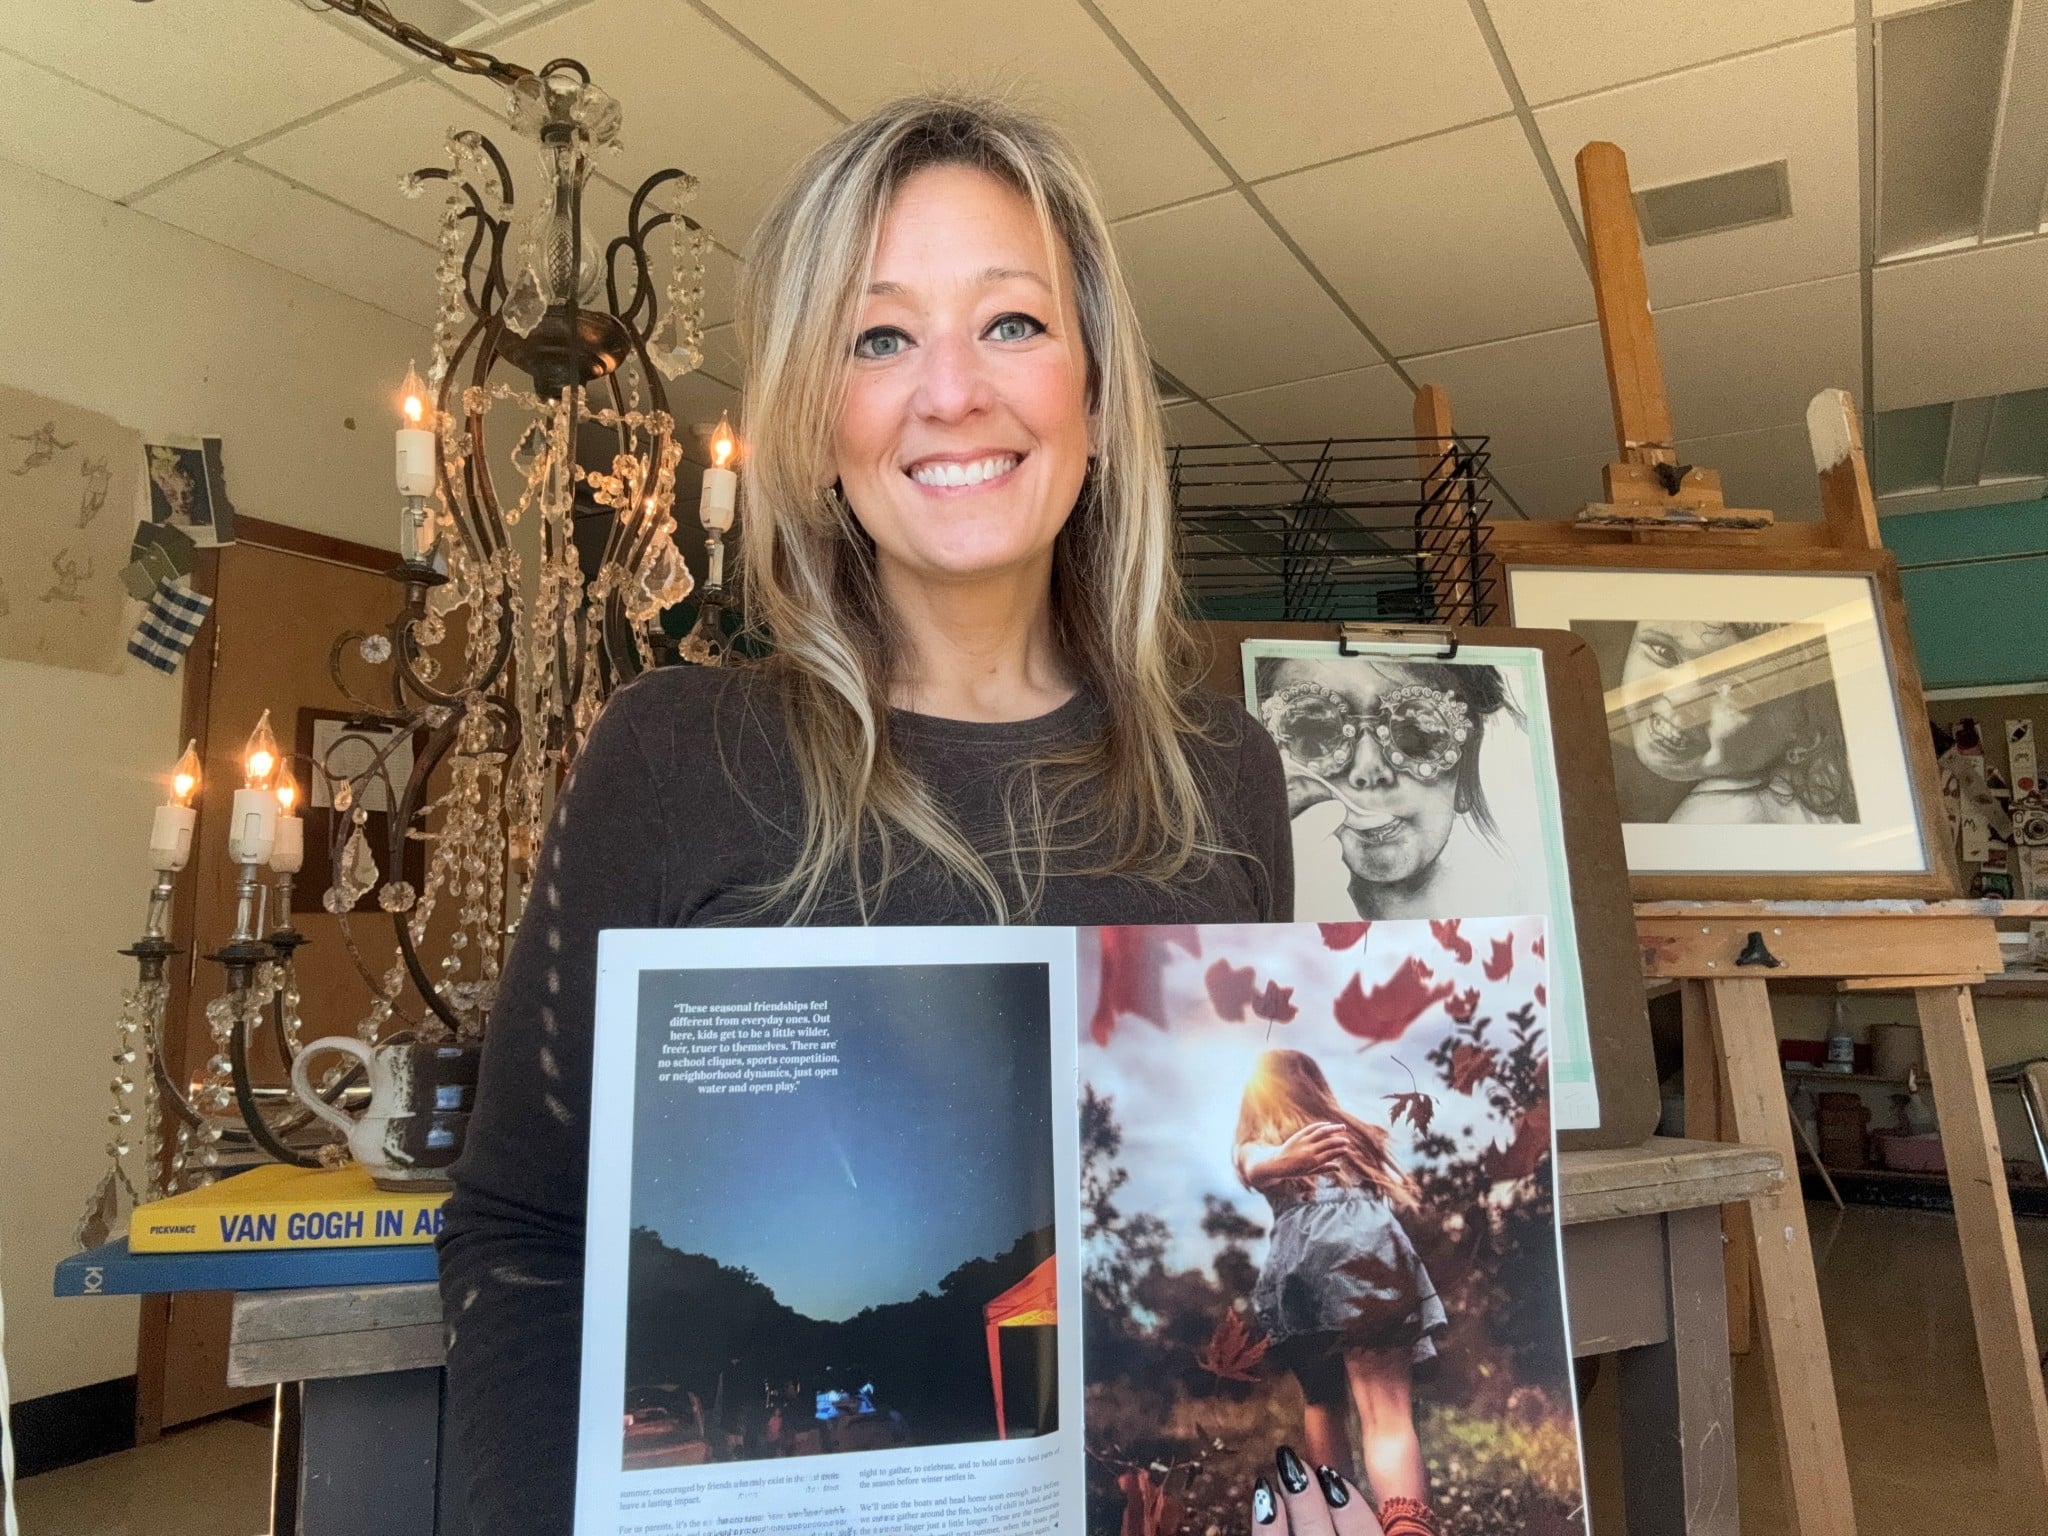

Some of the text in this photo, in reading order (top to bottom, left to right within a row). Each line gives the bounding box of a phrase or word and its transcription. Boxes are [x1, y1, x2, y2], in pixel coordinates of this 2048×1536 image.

[709, 1002, 752, 1013] seasonal
[753, 1001, 808, 1013] friendships
[810, 1000, 828, 1010] feel
[669, 1013, 831, 1027] different from everyday ones. Out
[670, 1026, 830, 1041] here, kids get to be a little wilder,
[662, 1041, 837, 1054] freer, truer to themselves. There are
[658, 1053, 840, 1068] no school cliques, sports competition,
[659, 1067, 838, 1083] or neighborhood dynamics, just open
[698, 1085, 727, 1093] water
[728, 1082, 747, 1093] and
[749, 1084, 773, 1094] open
[150, 1225, 196, 1235] PICKVANCE
[219, 1214, 276, 1242] VAN
[287, 1211, 363, 1240] GOGH
[375, 1209, 404, 1237] IN
[860, 1468, 878, 1478] night
[889, 1466, 912, 1476] gather,
[923, 1463, 957, 1472] celebrate,
[959, 1461, 971, 1469] and
[982, 1458, 997, 1467] hold
[1016, 1455, 1026, 1463] the
[620, 1488, 652, 1498] summer,
[653, 1484, 695, 1495] encouraged
[697, 1483, 706, 1493] by
[707, 1480, 732, 1490] friends
[768, 1476, 785, 1485] exist
[786, 1475, 793, 1483] in
[860, 1471, 976, 1489] the season before winter settles in.
[620, 1501, 640, 1511] leave
[648, 1498, 673, 1508] lasting
[675, 1496, 701, 1506] impact.
[881, 1501, 899, 1510] untie
[901, 1500, 912, 1508] the
[914, 1498, 932, 1507] boats
[934, 1496, 947, 1505] and
[949, 1494, 965, 1504] head
[967, 1494, 986, 1503] home
[989, 1493, 1004, 1501] soon
[896, 1510, 919, 1521] gather
[920, 1508, 945, 1518] around
[946, 1507, 957, 1515] the
[974, 1504, 993, 1513] bowls
[1003, 1500, 1018, 1509] chili
[619, 1526, 632, 1534] For
[645, 1523, 674, 1533] parents,
[689, 1519, 701, 1527] the
[904, 1522, 925, 1532] linger
[926, 1520, 940, 1530] just
[948, 1518, 964, 1527] little
[992, 1513, 1010, 1522] These
[1003, 1523, 1020, 1531] when
[1021, 1520, 1031, 1528] the
